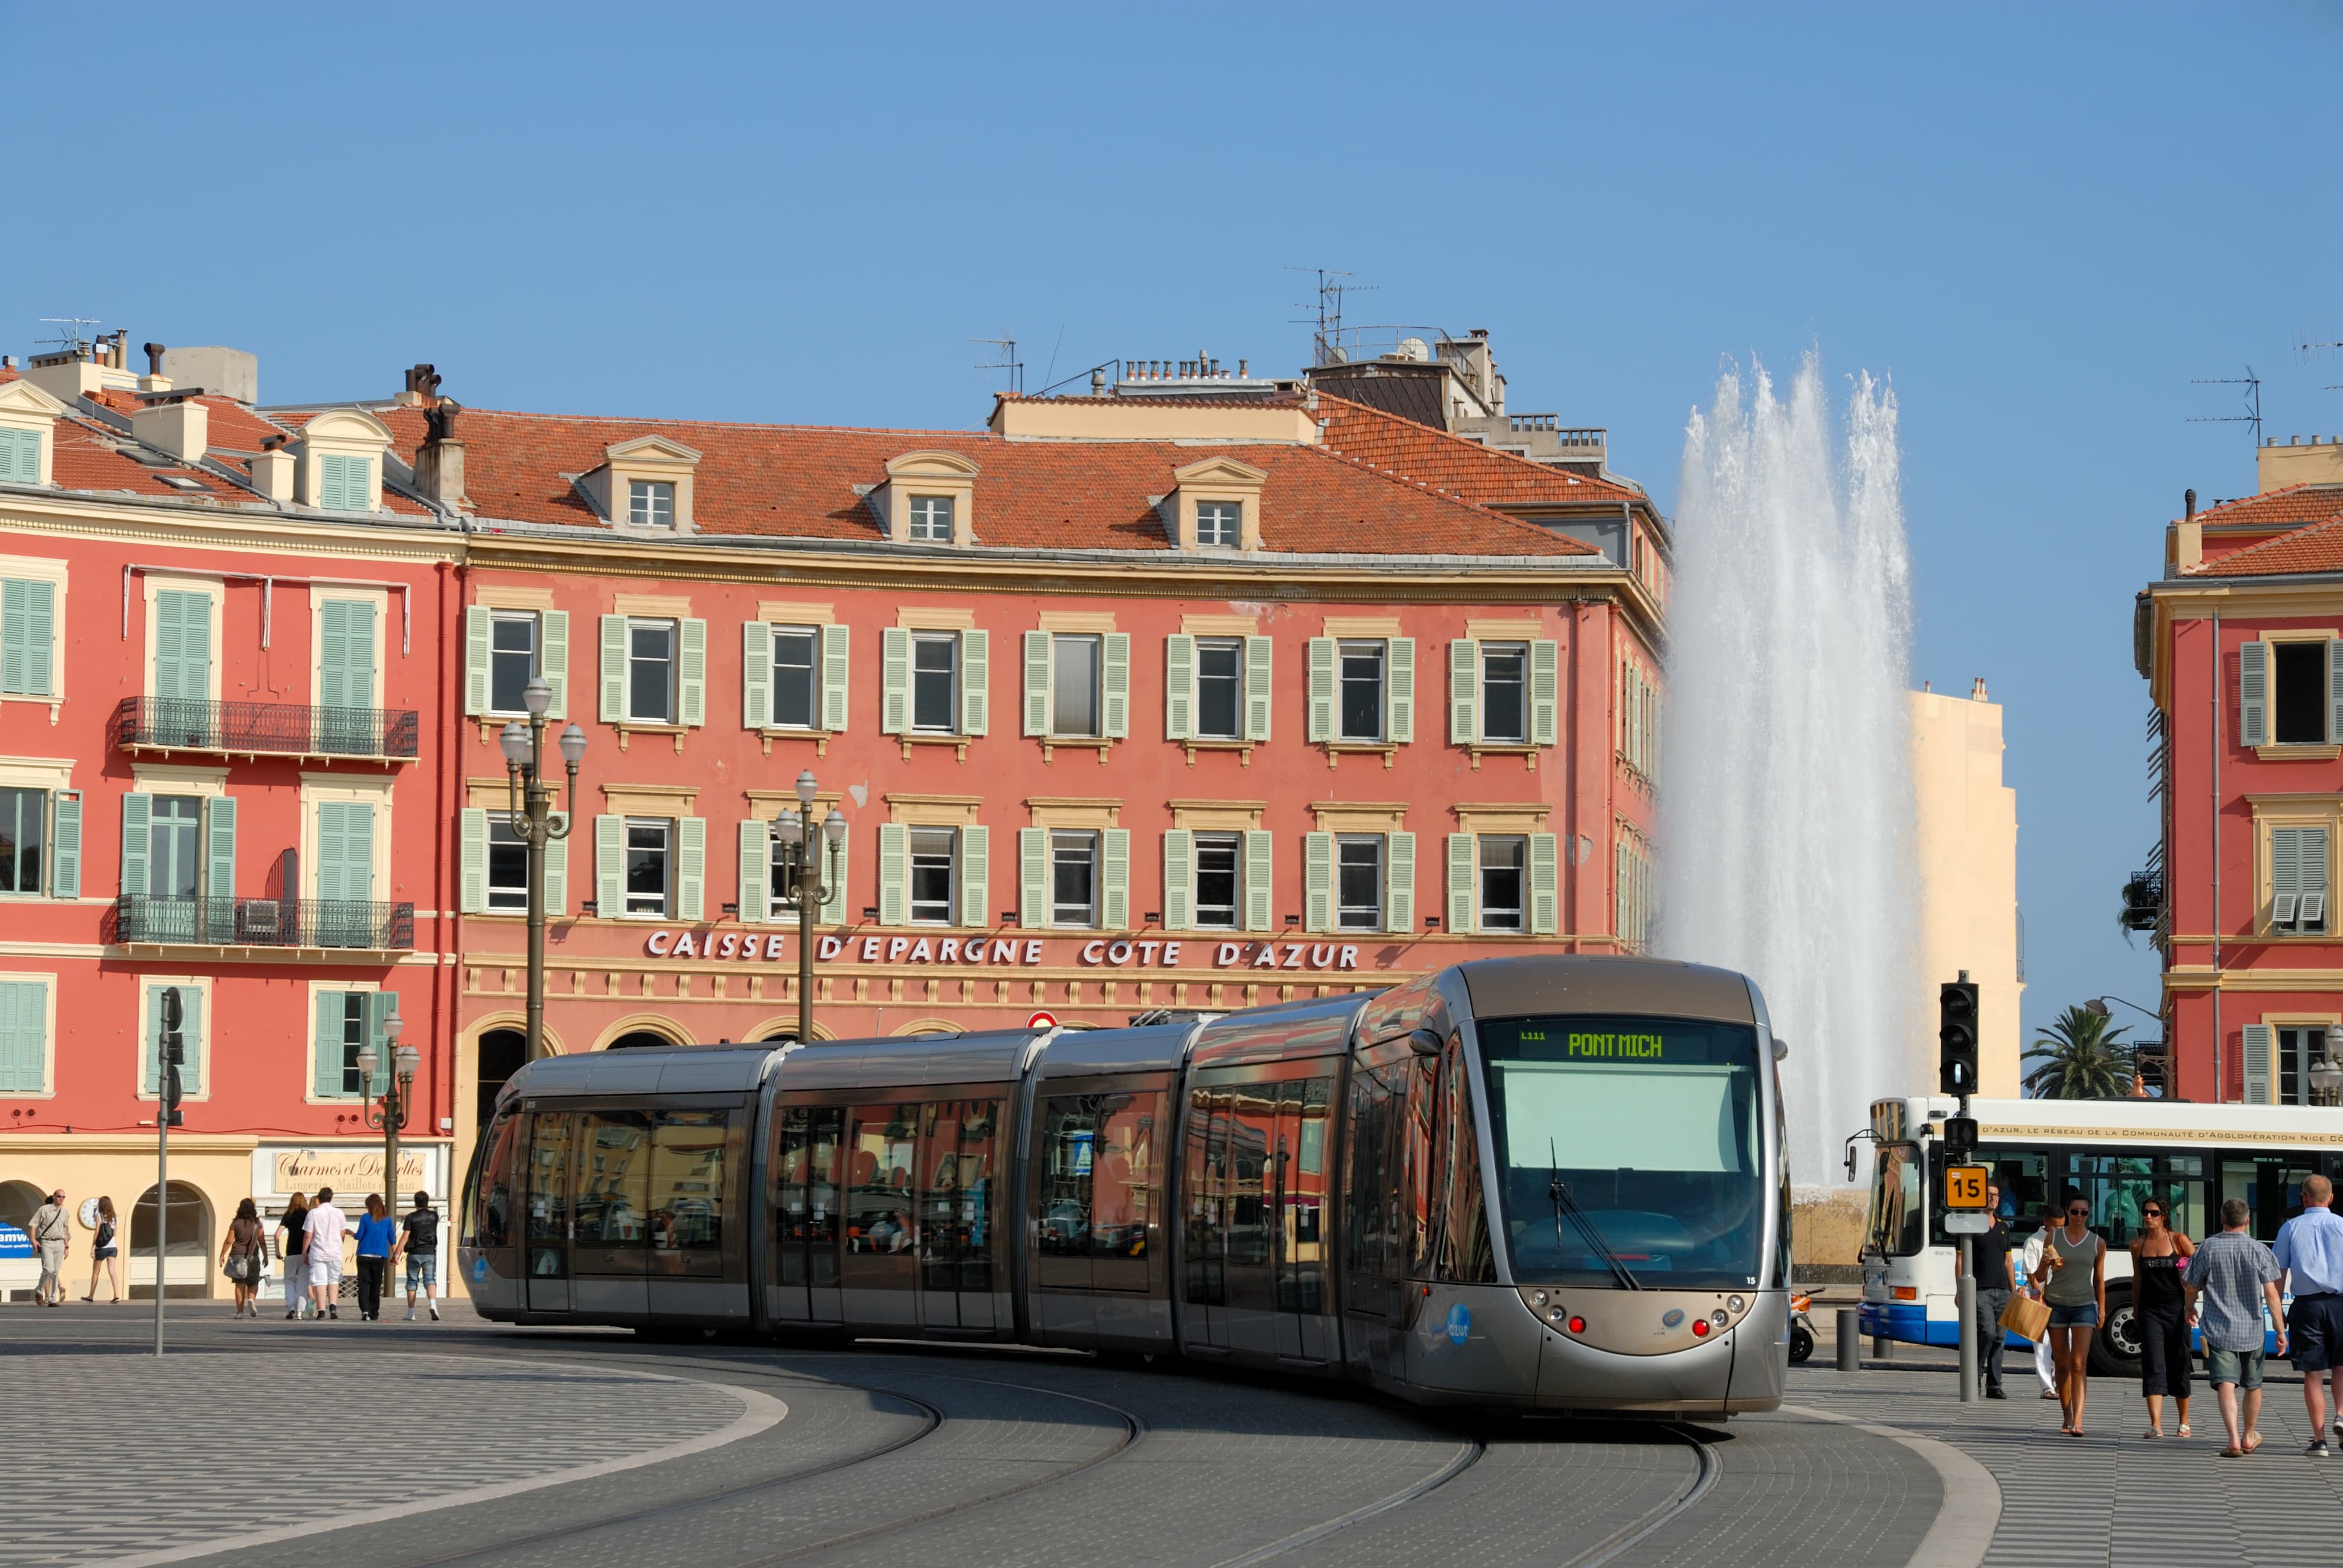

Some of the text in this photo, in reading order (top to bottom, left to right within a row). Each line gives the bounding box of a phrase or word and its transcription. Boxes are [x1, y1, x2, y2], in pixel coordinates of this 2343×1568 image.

[647, 930, 1359, 969] CAISSE D'EPARGNE COTE D'AZUR
[1521, 1031, 1545, 1040] L111
[1568, 1033, 1662, 1057] PONT MICH
[1982, 1126, 2023, 1134] D'AZUR,
[2043, 1126, 2083, 1135] RÉSEAU
[277, 1152, 424, 1177] Charmes et Deelles
[285, 1178, 327, 1191] Lingerie
[336, 1178, 376, 1191] Maillots
[395, 1180, 415, 1191] ain
[1953, 1178, 1980, 1198] 15
[1746, 1276, 1756, 1285] 15
